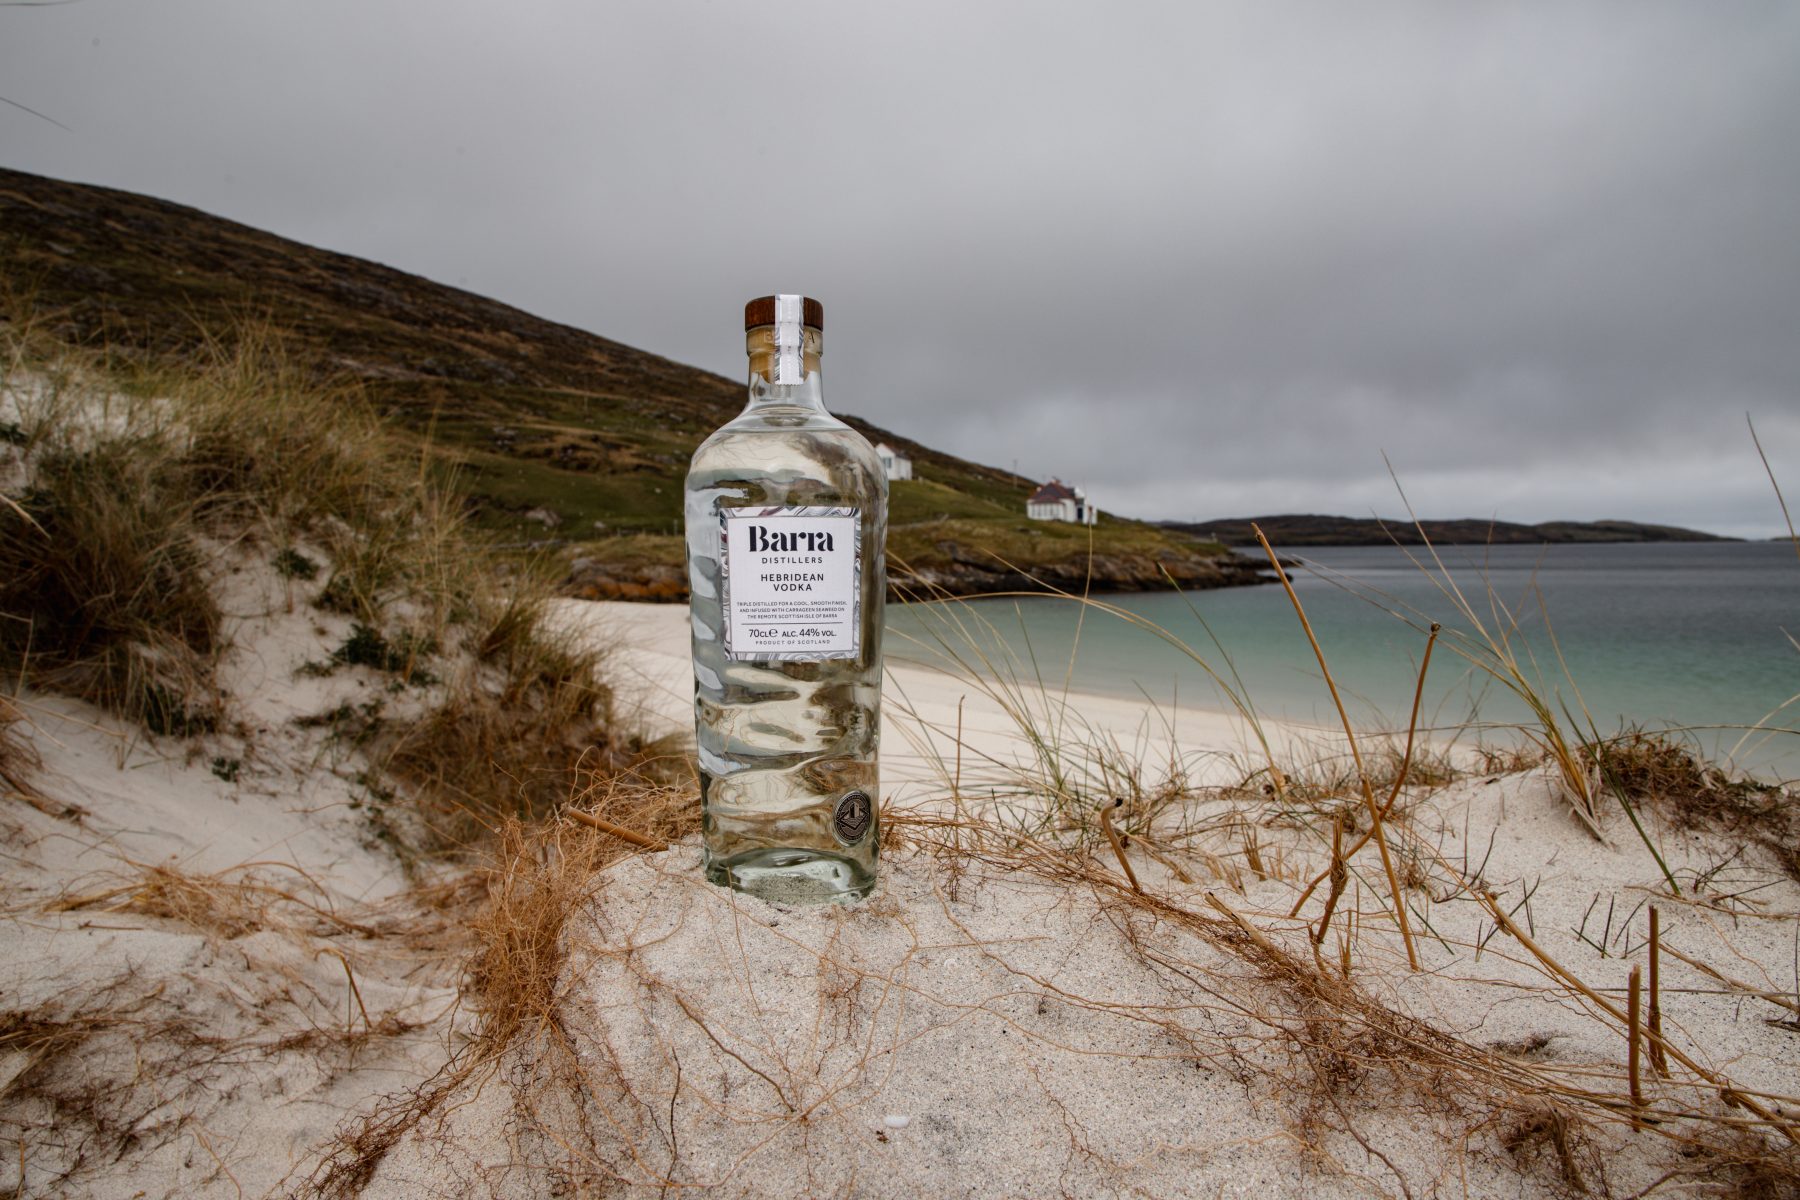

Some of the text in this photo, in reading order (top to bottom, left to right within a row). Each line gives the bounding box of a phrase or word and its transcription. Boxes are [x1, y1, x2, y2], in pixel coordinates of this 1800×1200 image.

[748, 525, 835, 552] Barra
[761, 556, 823, 564] DISTILLERS
[760, 573, 824, 582] HEBRIDEAN
[773, 583, 813, 592] VODKA
[799, 628, 820, 637] 44%
